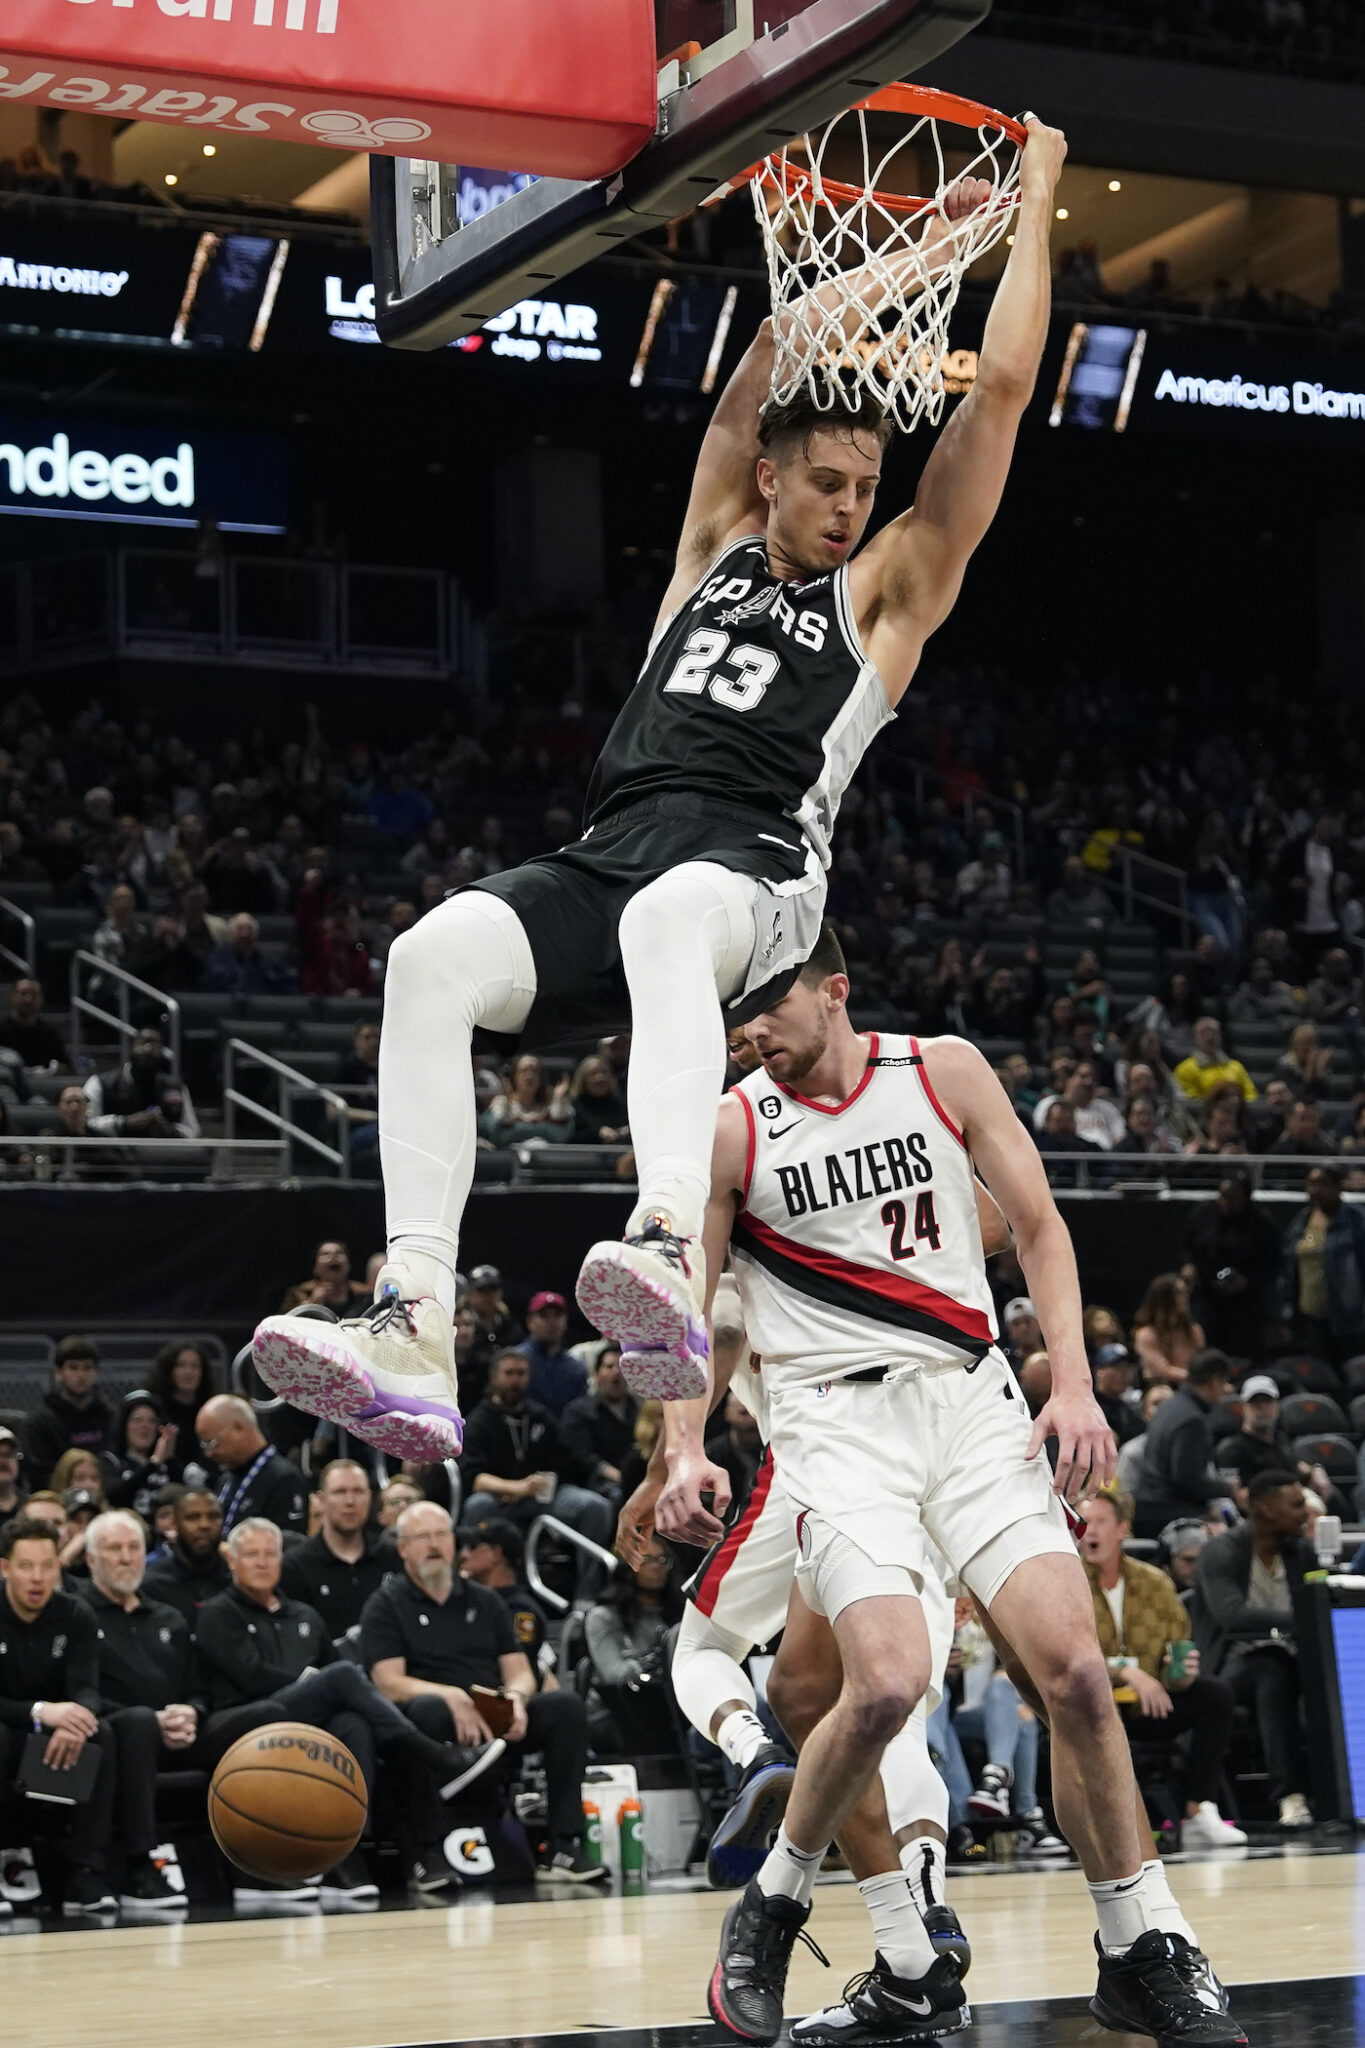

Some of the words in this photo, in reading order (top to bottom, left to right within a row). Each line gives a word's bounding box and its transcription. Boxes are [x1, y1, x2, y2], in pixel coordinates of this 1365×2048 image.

[1154, 368, 1290, 413] Americus
[663, 626, 781, 712] 23
[762, 1097, 780, 1118] 6
[773, 1132, 933, 1218] BLAZERS
[881, 1190, 942, 1261] 24
